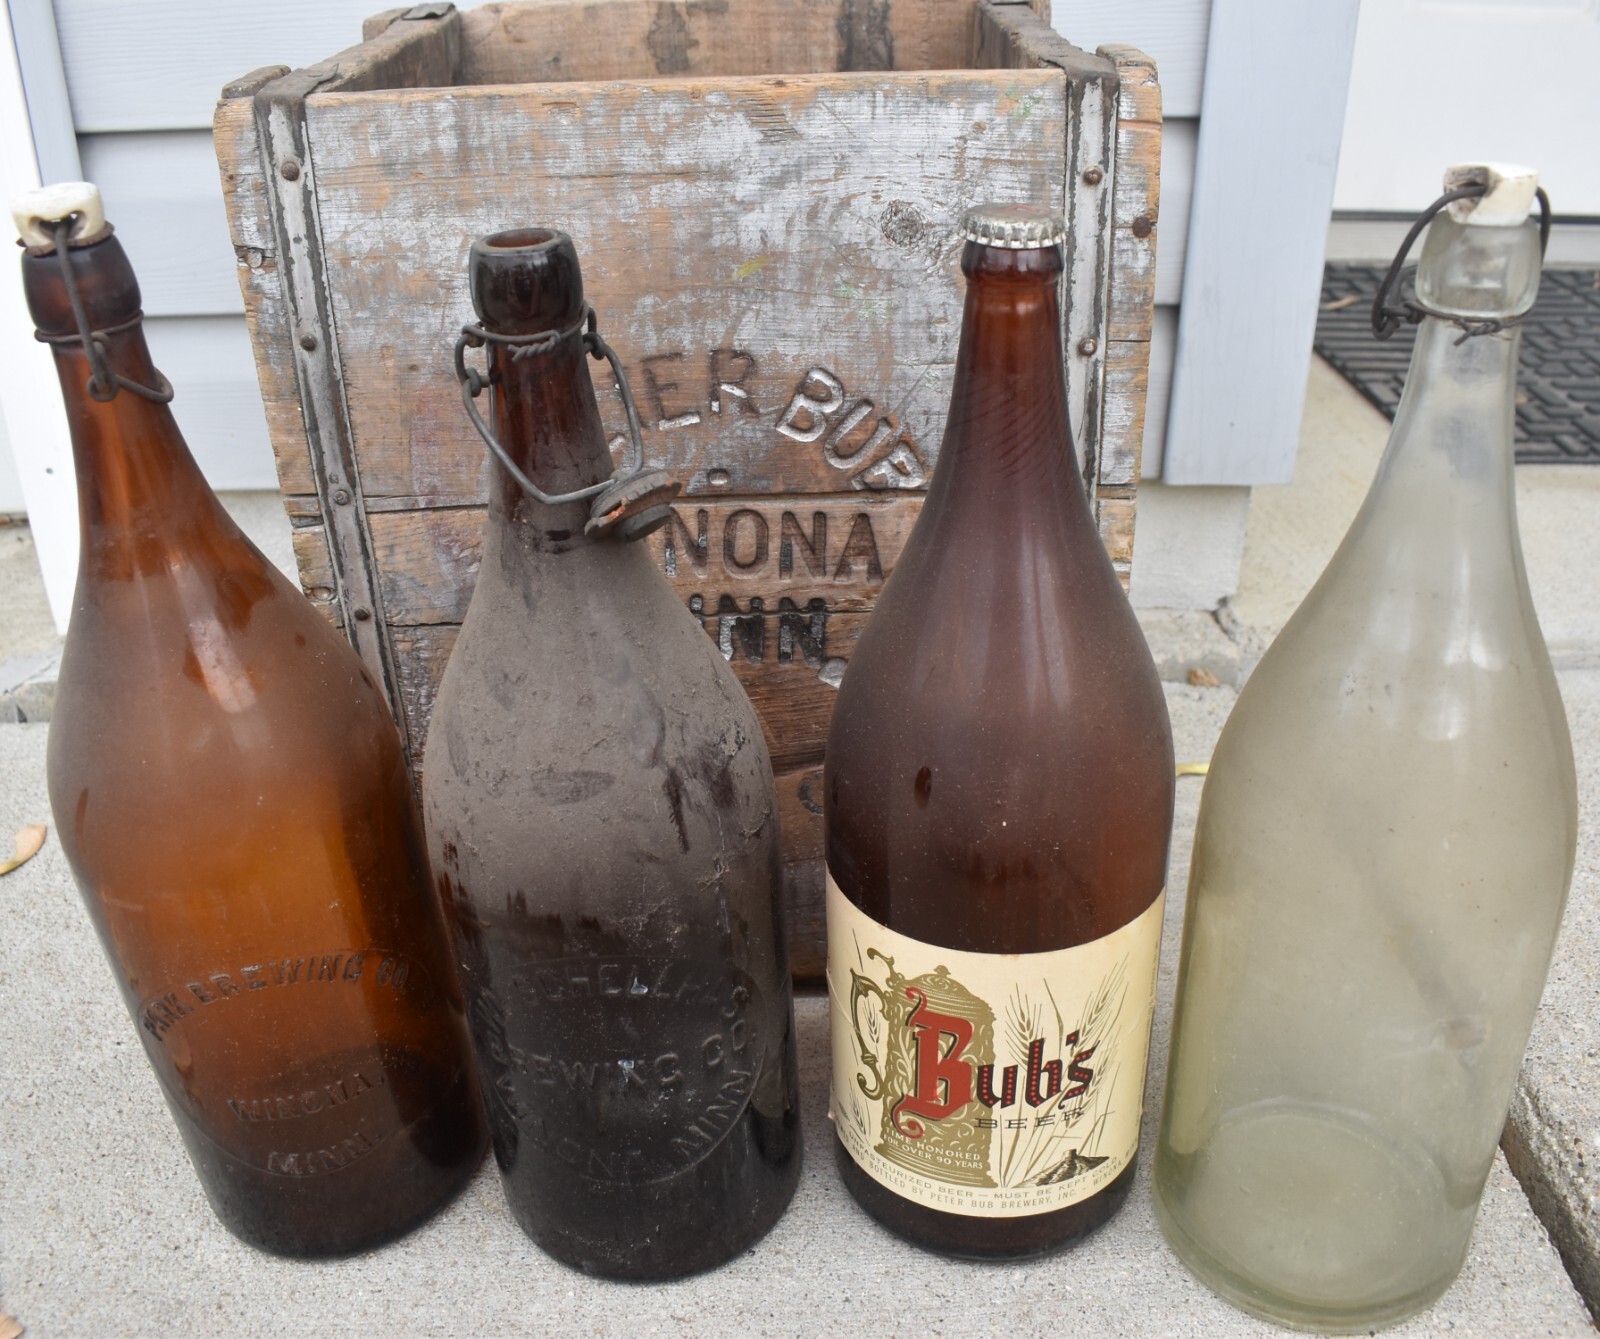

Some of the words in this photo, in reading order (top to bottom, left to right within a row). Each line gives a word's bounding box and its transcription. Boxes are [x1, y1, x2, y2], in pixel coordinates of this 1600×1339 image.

[186, 953, 366, 1005] BREWING
[891, 986, 1101, 1138] Bub's
[973, 1107, 1085, 1129] BEER
[885, 1126, 912, 1145] TIME
[916, 1141, 981, 1161] HONORED
[901, 1144, 933, 1161] OVER
[936, 1156, 952, 1165] 90
[954, 1160, 983, 1170] YEARS
[868, 1161, 906, 1189] BOTTLED
[911, 1185, 925, 1197] BY
[930, 1192, 964, 1207] PETER
[971, 1200, 994, 1209] BUB
[938, 1186, 974, 1197] BEER
[993, 1191, 1030, 1199] MUST
[1036, 1188, 1053, 1196] BE
[1058, 1176, 1088, 1191] KEPT
